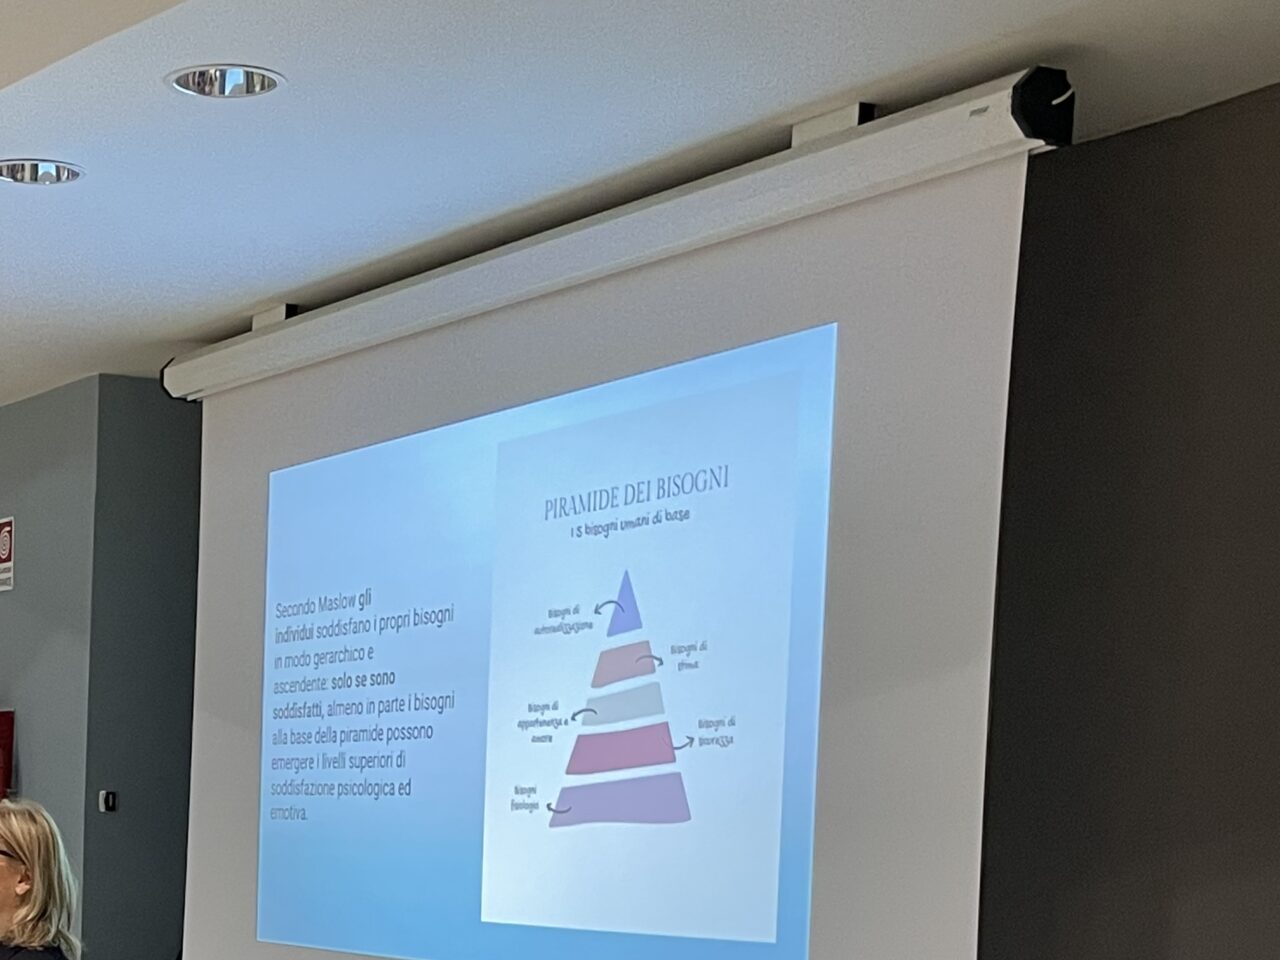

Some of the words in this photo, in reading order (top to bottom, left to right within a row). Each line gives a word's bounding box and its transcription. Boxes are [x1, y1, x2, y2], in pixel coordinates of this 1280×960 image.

[545, 486, 619, 520] PIRAMIDE
[624, 480, 651, 505] DEI
[657, 465, 728, 499] BISOGNI
[585, 518, 618, 538] bisogni
[620, 512, 650, 530] umani
[652, 509, 663, 524] di
[665, 508, 690, 522] base
[276, 598, 316, 618] Secondo
[319, 592, 356, 612] Maslow
[359, 588, 372, 611] gli
[275, 623, 314, 644] individui
[316, 617, 371, 639] soddisfano
[379, 608, 410, 635] propri
[413, 603, 455, 628] bisogni
[275, 655, 283, 669] in
[284, 650, 311, 668] modo
[313, 645, 365, 670] gerarchico
[367, 646, 374, 660] e
[331, 672, 352, 690] solo
[355, 674, 367, 688] se
[370, 671, 396, 686] sono
[273, 701, 325, 720] soddisfatti,
[327, 700, 364, 717] almeno
[366, 698, 376, 715] in
[378, 696, 405, 719] parte
[414, 690, 455, 715] bisogni
[272, 728, 288, 746] alla
[290, 728, 312, 745] base
[314, 726, 337, 744] della
[340, 724, 384, 747] piramide
[386, 725, 434, 746] possono
[271, 756, 314, 774] emergere
[322, 752, 346, 769] livelli
[348, 751, 393, 773] superiori
[395, 750, 406, 768] di
[271, 779, 336, 796] soddisfazione
[337, 778, 395, 800] psicologica
[397, 777, 412, 796] ed
[270, 805, 309, 820] emotiva.
